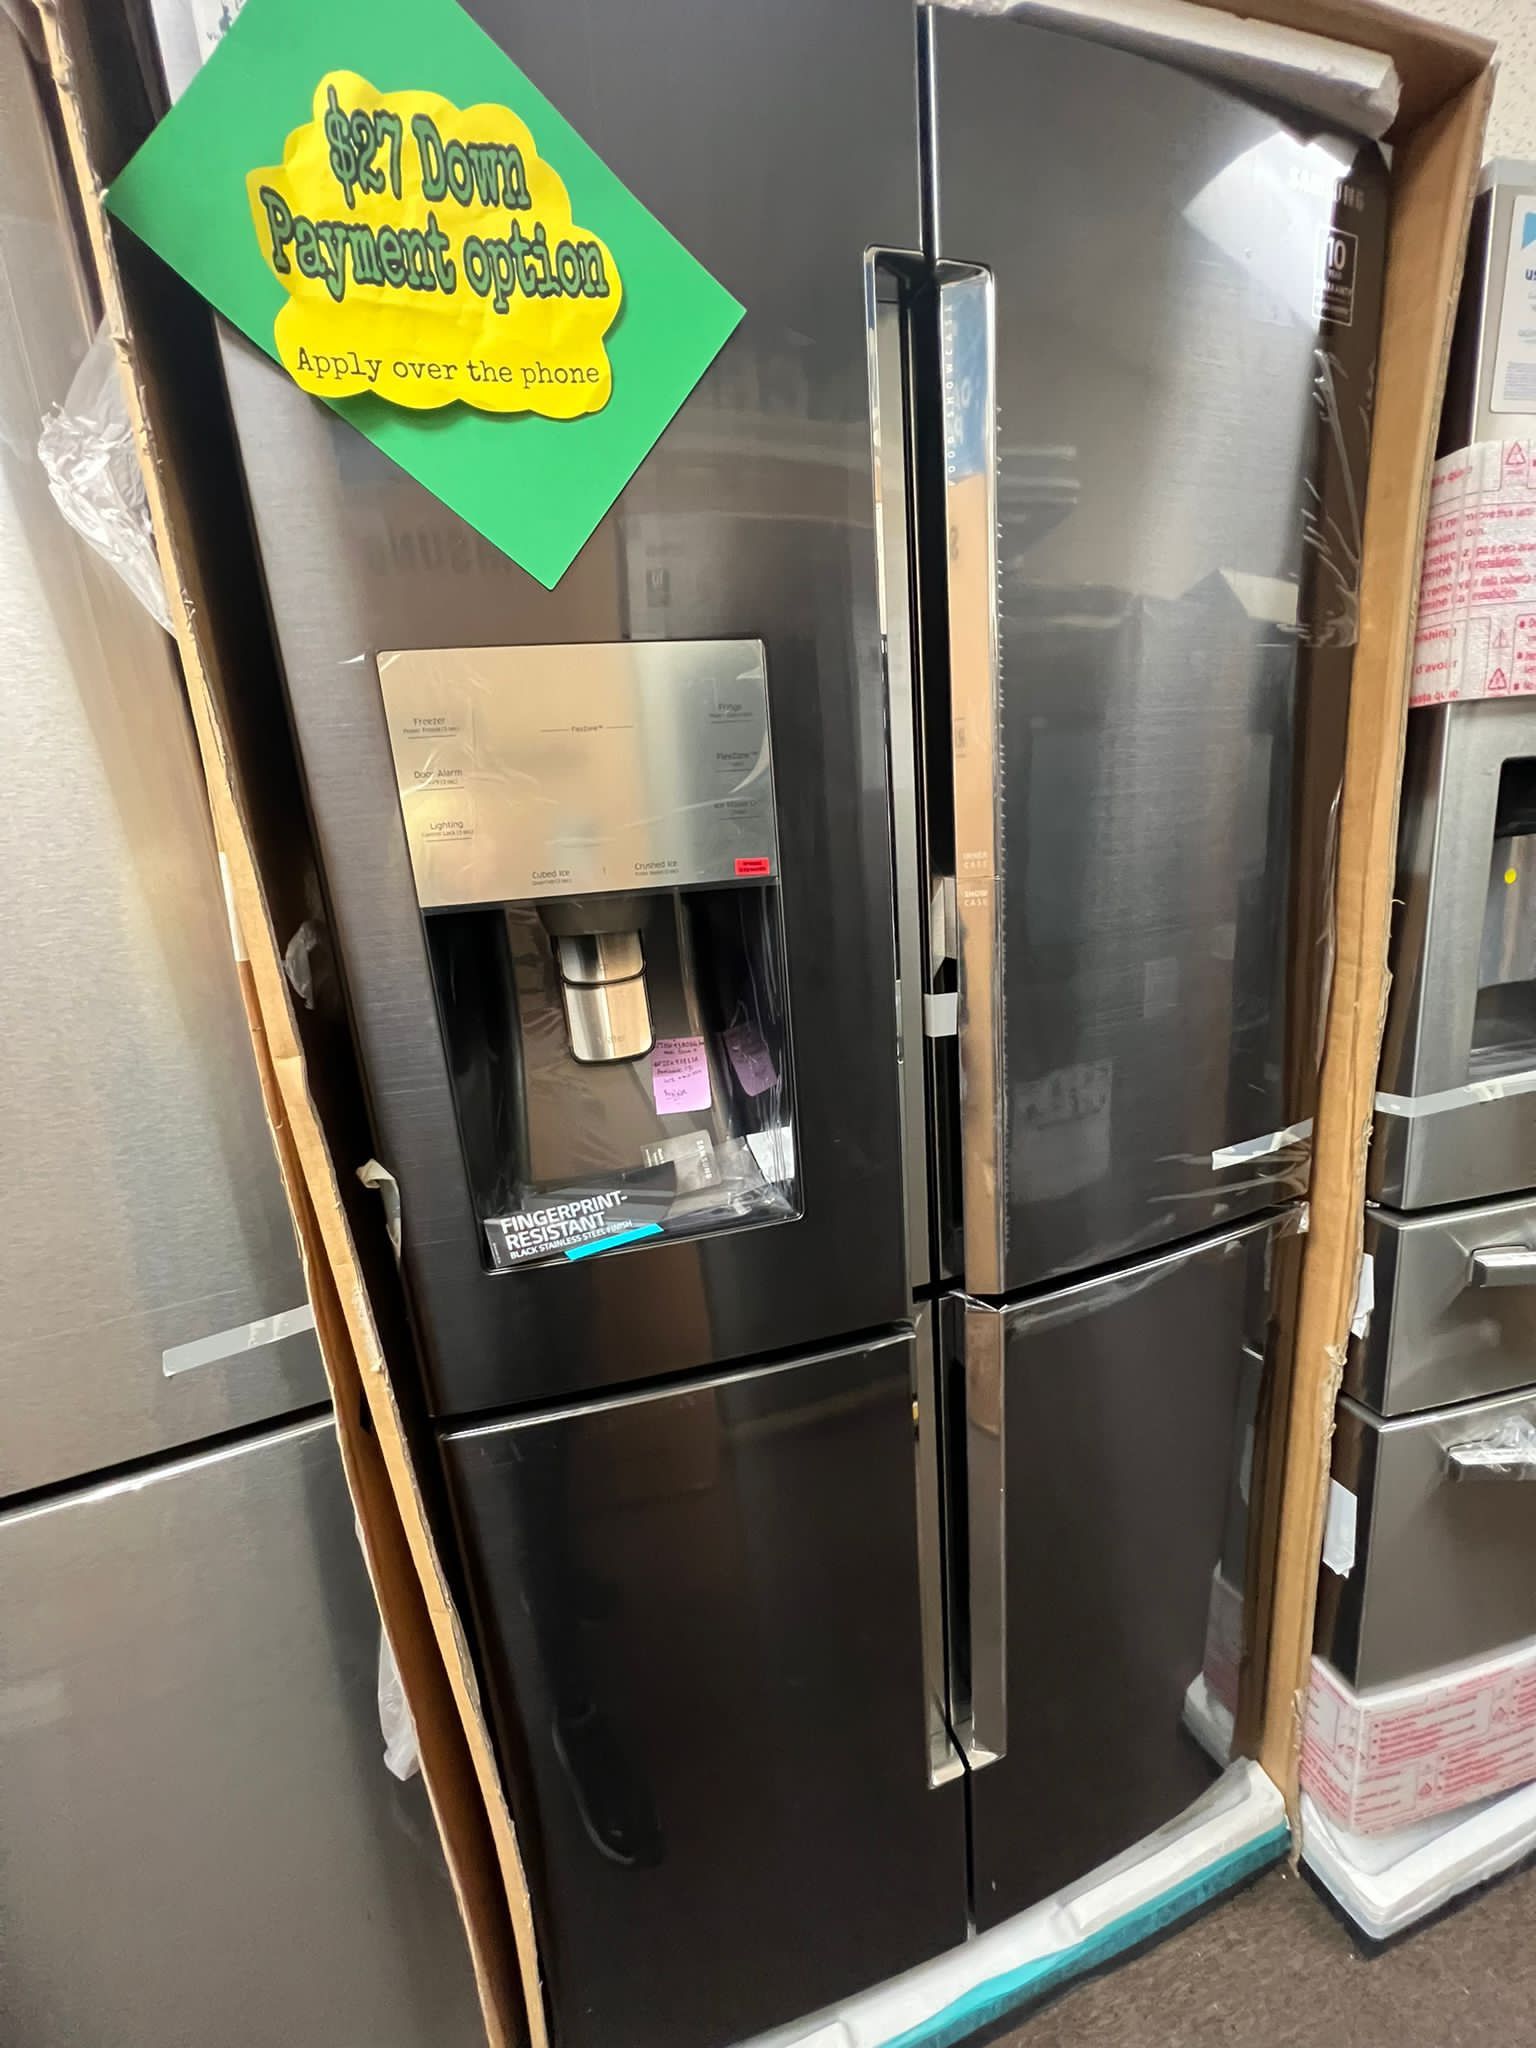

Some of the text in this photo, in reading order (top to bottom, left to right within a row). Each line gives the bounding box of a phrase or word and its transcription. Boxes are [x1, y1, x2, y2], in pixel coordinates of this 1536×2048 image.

[325, 84, 531, 210] $27 Down
[259, 185, 610, 313] Payment option
[297, 347, 600, 388] Apply over the phone
[438, 769, 463, 777] Alarm
[430, 821, 464, 831] Lighting
[532, 870, 557, 879] Cubed
[500, 1190, 628, 1234] FINGERPRINT-
[505, 1211, 605, 1251] RESISTANT
[510, 1246, 538, 1260] BLACK
[539, 1234, 582, 1252] STAINLESS
[582, 1228, 606, 1240] STEEL
